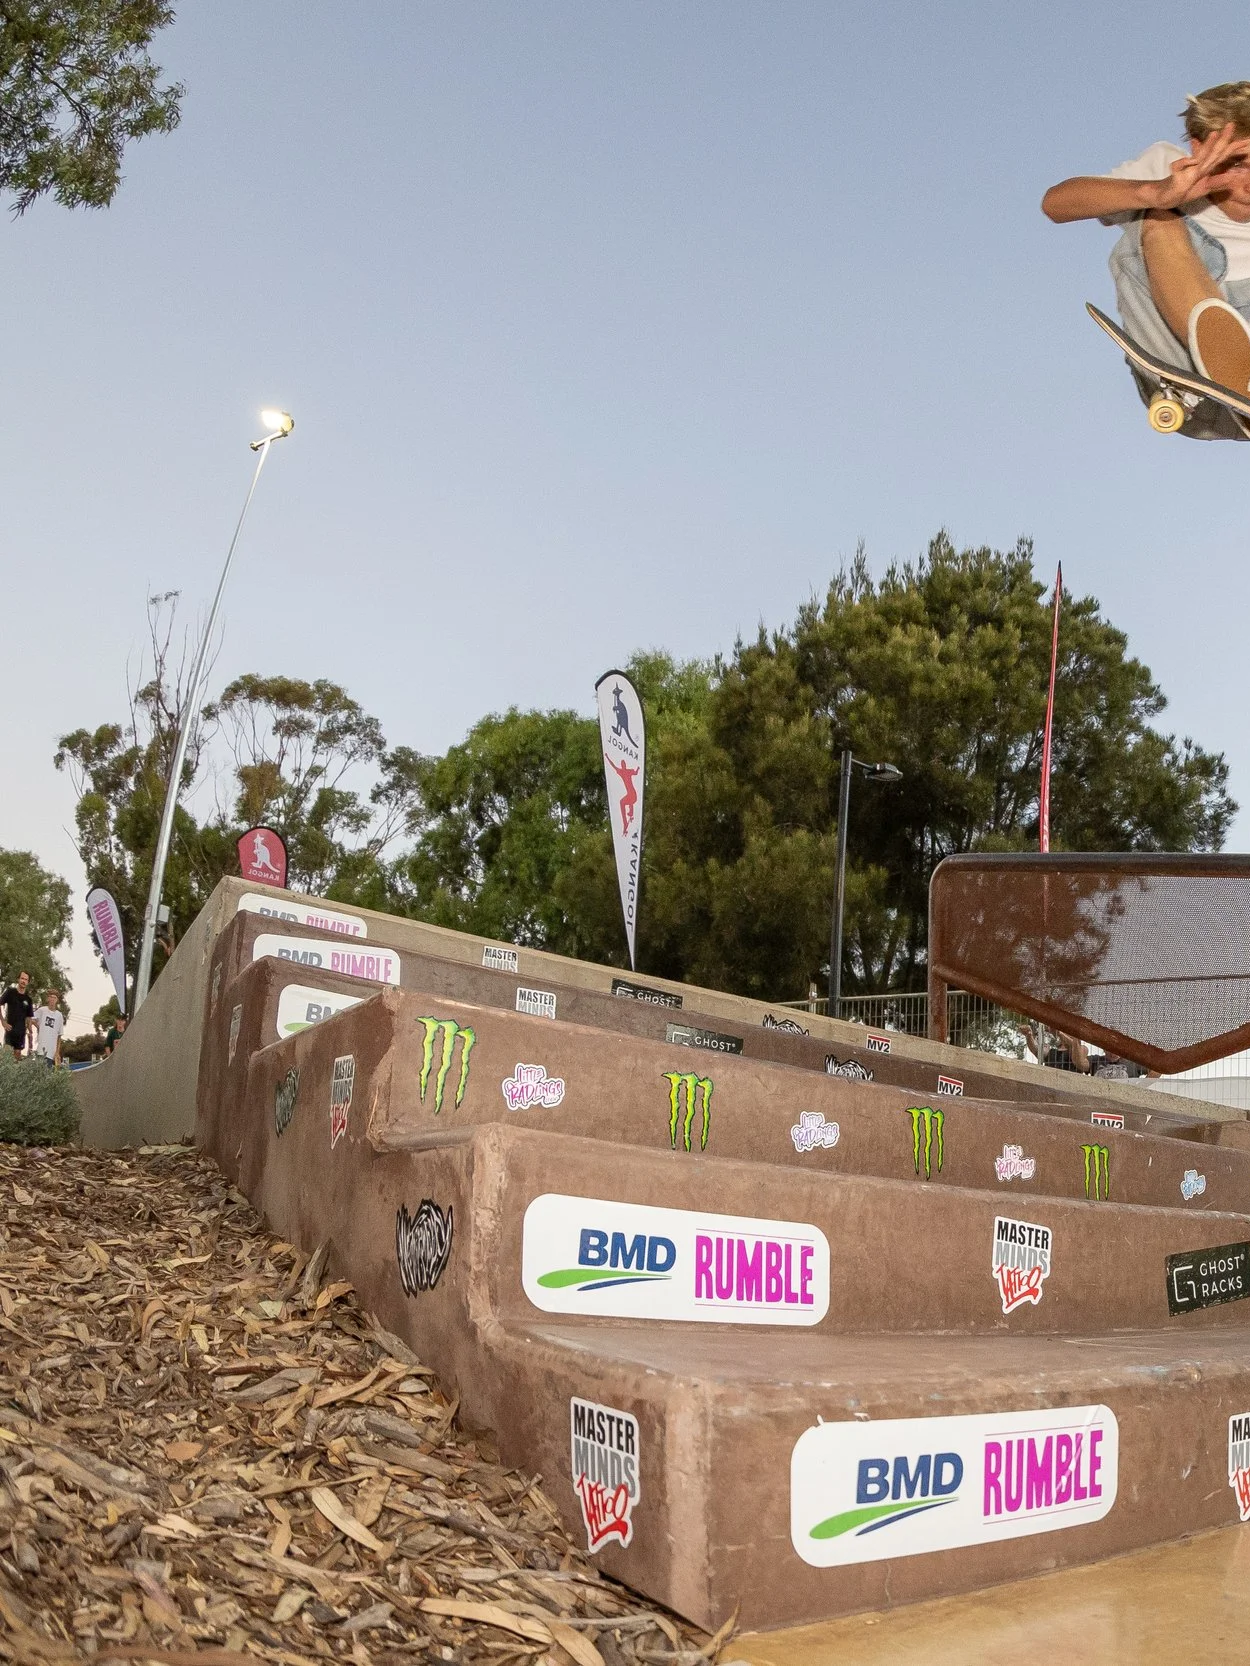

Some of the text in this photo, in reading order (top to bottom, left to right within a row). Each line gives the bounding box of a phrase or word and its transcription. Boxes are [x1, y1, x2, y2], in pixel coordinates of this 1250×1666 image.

[92, 899, 122, 956] RUMBLE
[484, 947, 517, 962] MASTER
[518, 989, 554, 1006] MASTER
[867, 1039, 890, 1053] MV2
[939, 1081, 962, 1096] MV2
[997, 1220, 1049, 1250] MASTER
[578, 1228, 814, 1304] BMD RUMBLE
[995, 1241, 1048, 1275] MINDS
[1202, 1276, 1243, 1297] RACKS
[573, 1403, 635, 1456] MASTER
[574, 1437, 636, 1498] MINDS
[856, 1430, 1103, 1516] BMD RUMBLE
